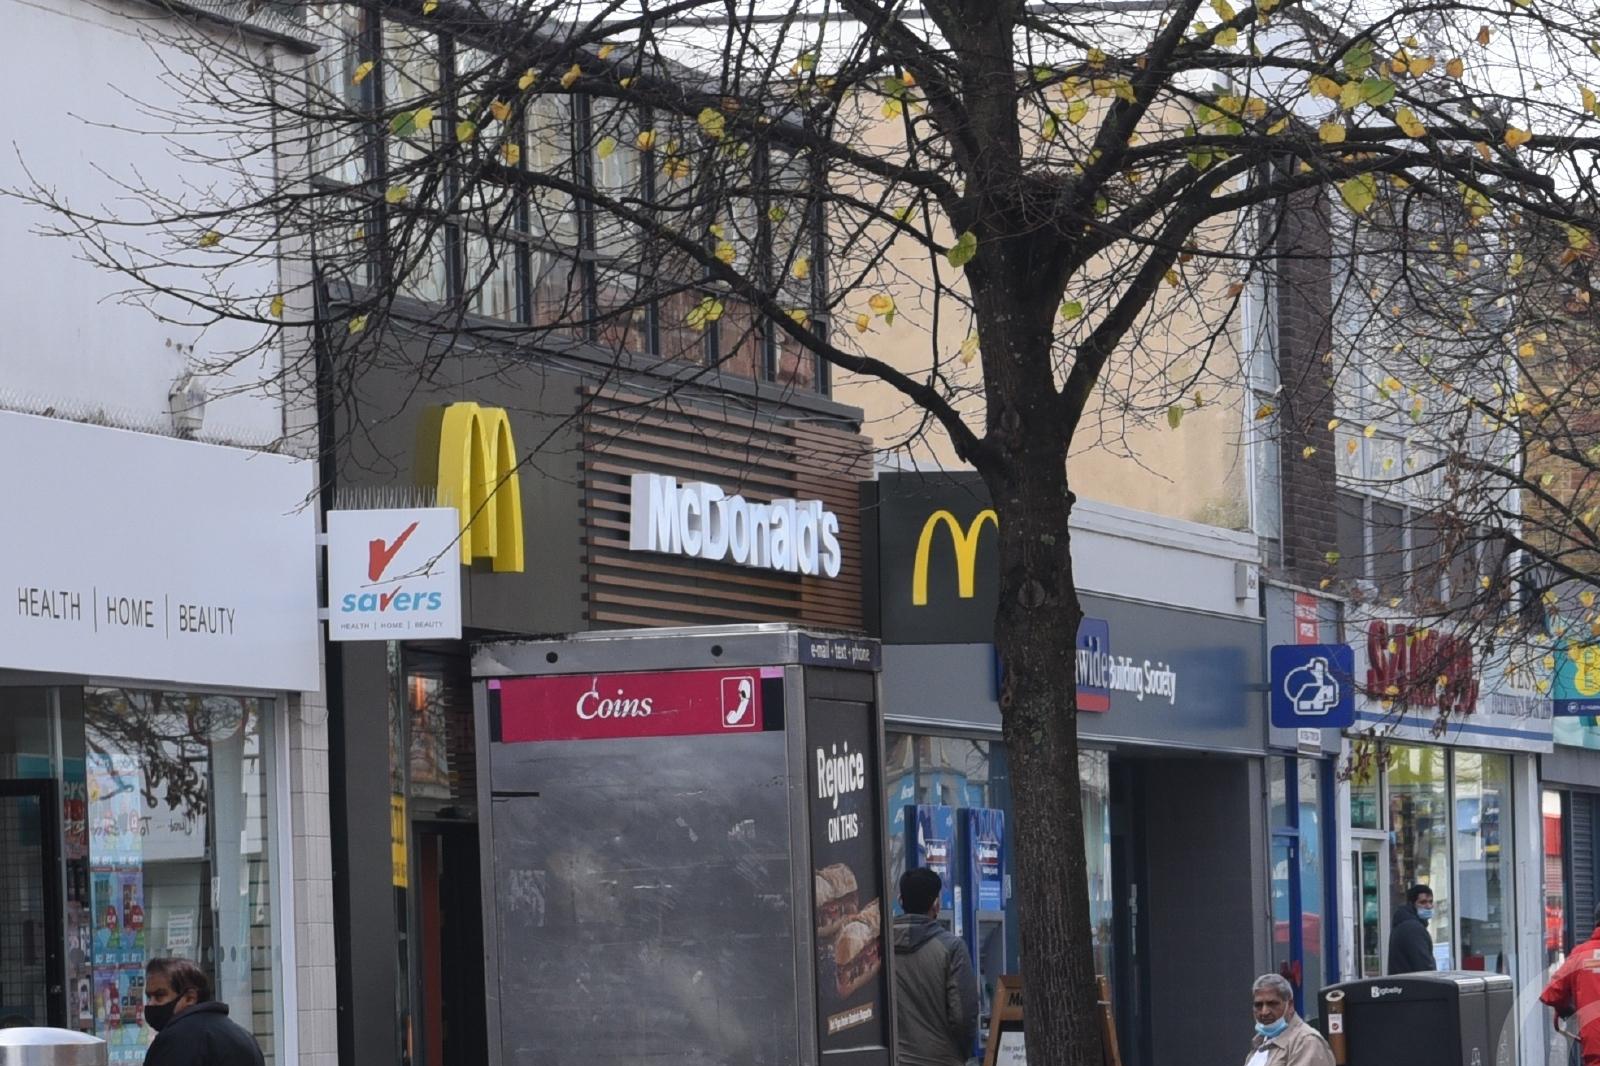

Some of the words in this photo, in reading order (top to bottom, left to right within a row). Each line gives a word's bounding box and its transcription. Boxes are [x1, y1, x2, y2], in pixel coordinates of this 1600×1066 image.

[631, 473, 842, 578] McDonald's
[17, 586, 82, 621] HEALTH
[106, 595, 155, 628] HOME
[178, 603, 236, 636] BEAUTY
[341, 585, 442, 612] savers
[576, 688, 654, 721] Coins
[1109, 655, 1143, 702] Building
[1143, 659, 1177, 705] Society
[816, 740, 865, 810] Rejoice
[828, 817, 840, 844] ON
[840, 813, 858, 840] THIS
